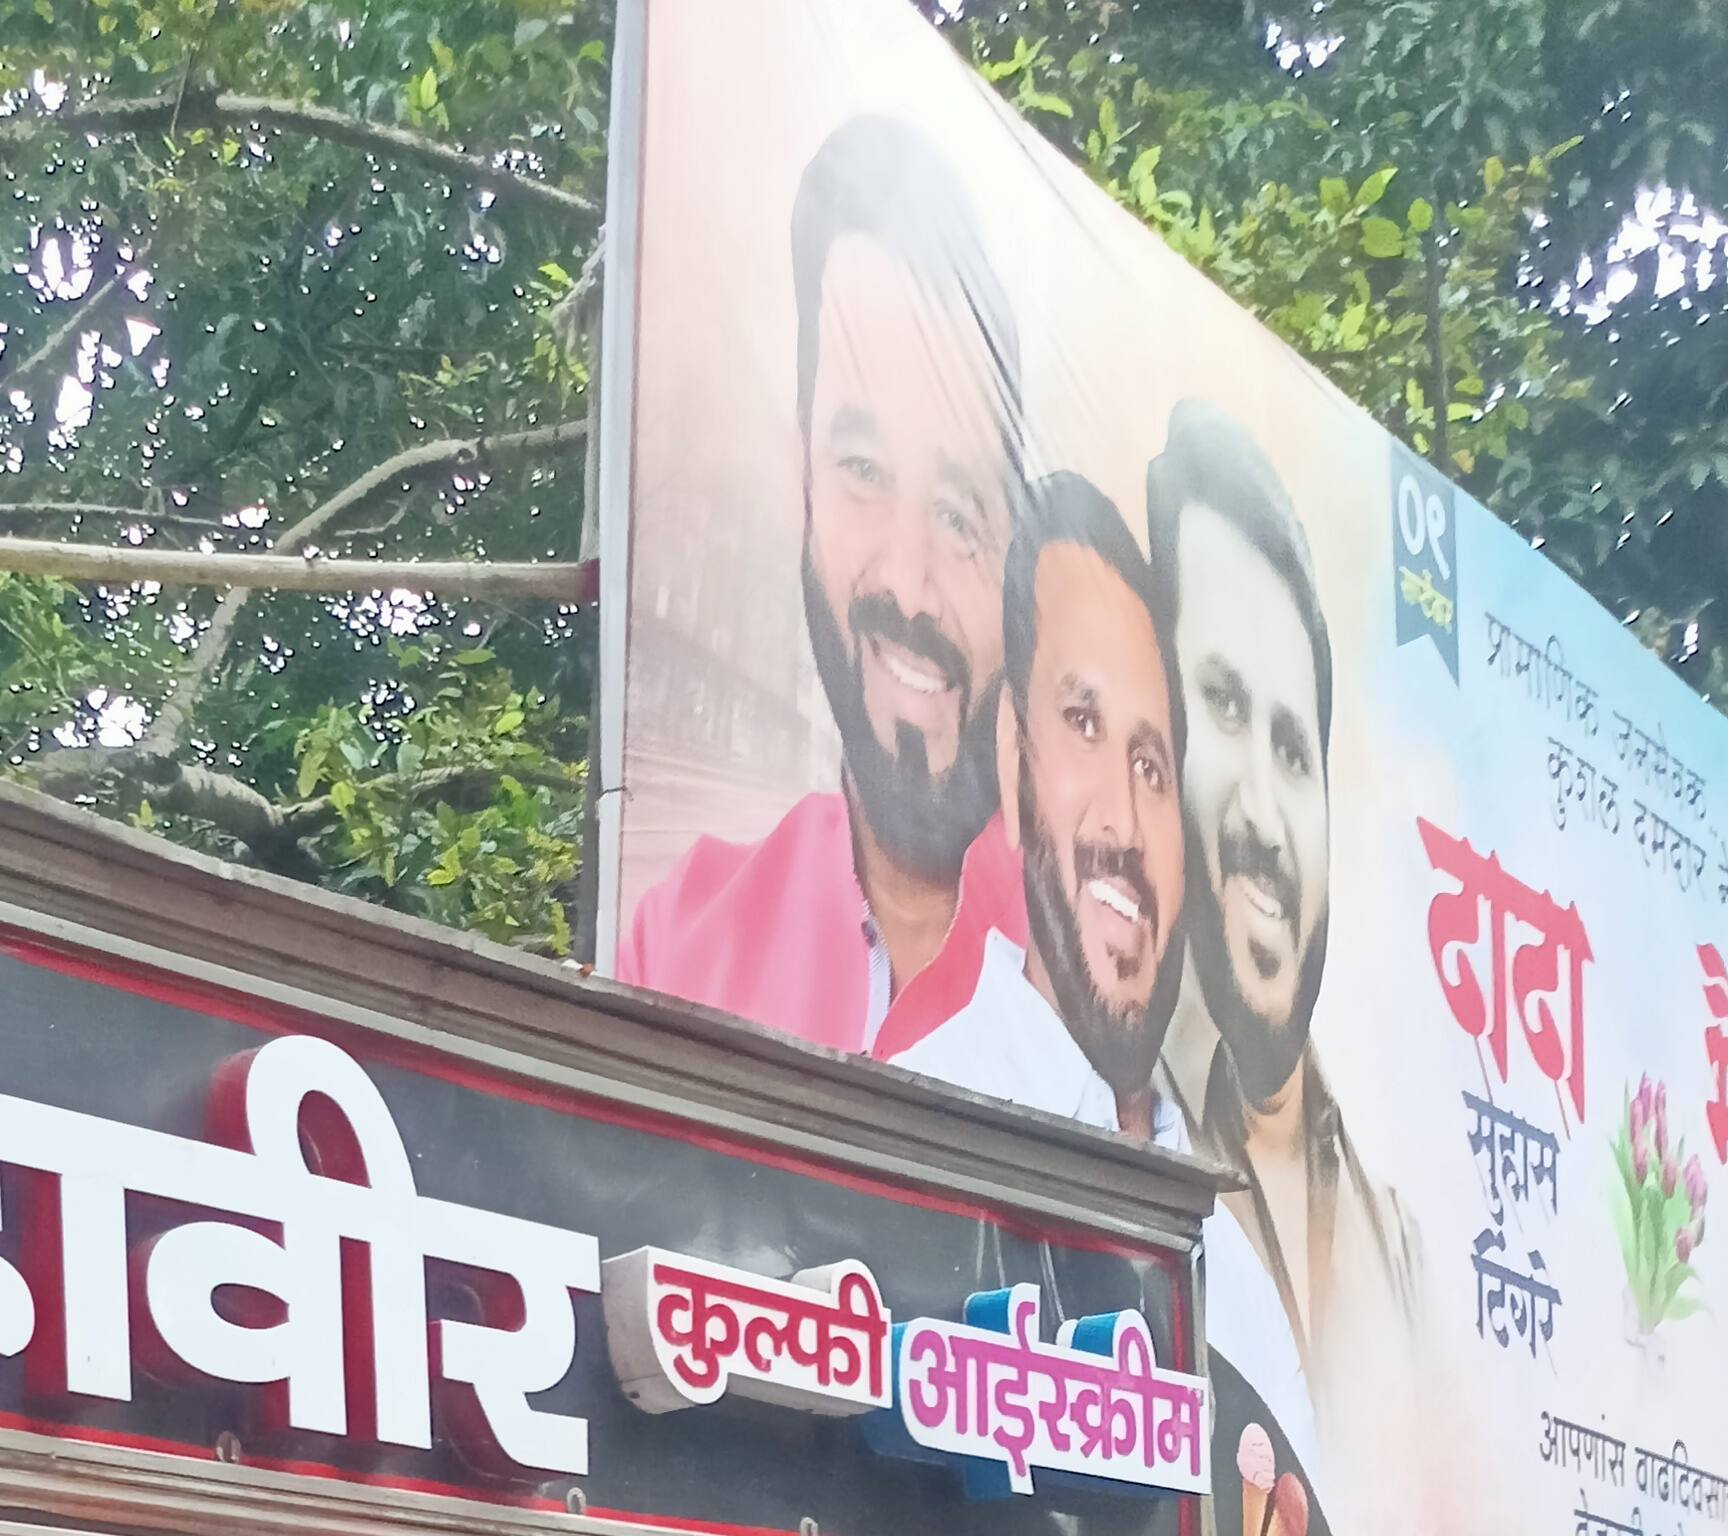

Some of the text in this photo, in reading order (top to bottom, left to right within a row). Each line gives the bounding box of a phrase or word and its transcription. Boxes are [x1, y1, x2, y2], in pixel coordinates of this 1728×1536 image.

[1417, 816, 1595, 1140] दादा
[1461, 1089, 1561, 1228] सुहास
[651, 1262, 889, 1397] कुल्फी
[908, 1298, 1205, 1478] आईस्क्रीम
[1539, 1410, 1728, 1525] आपणांस वाढदिवसा
